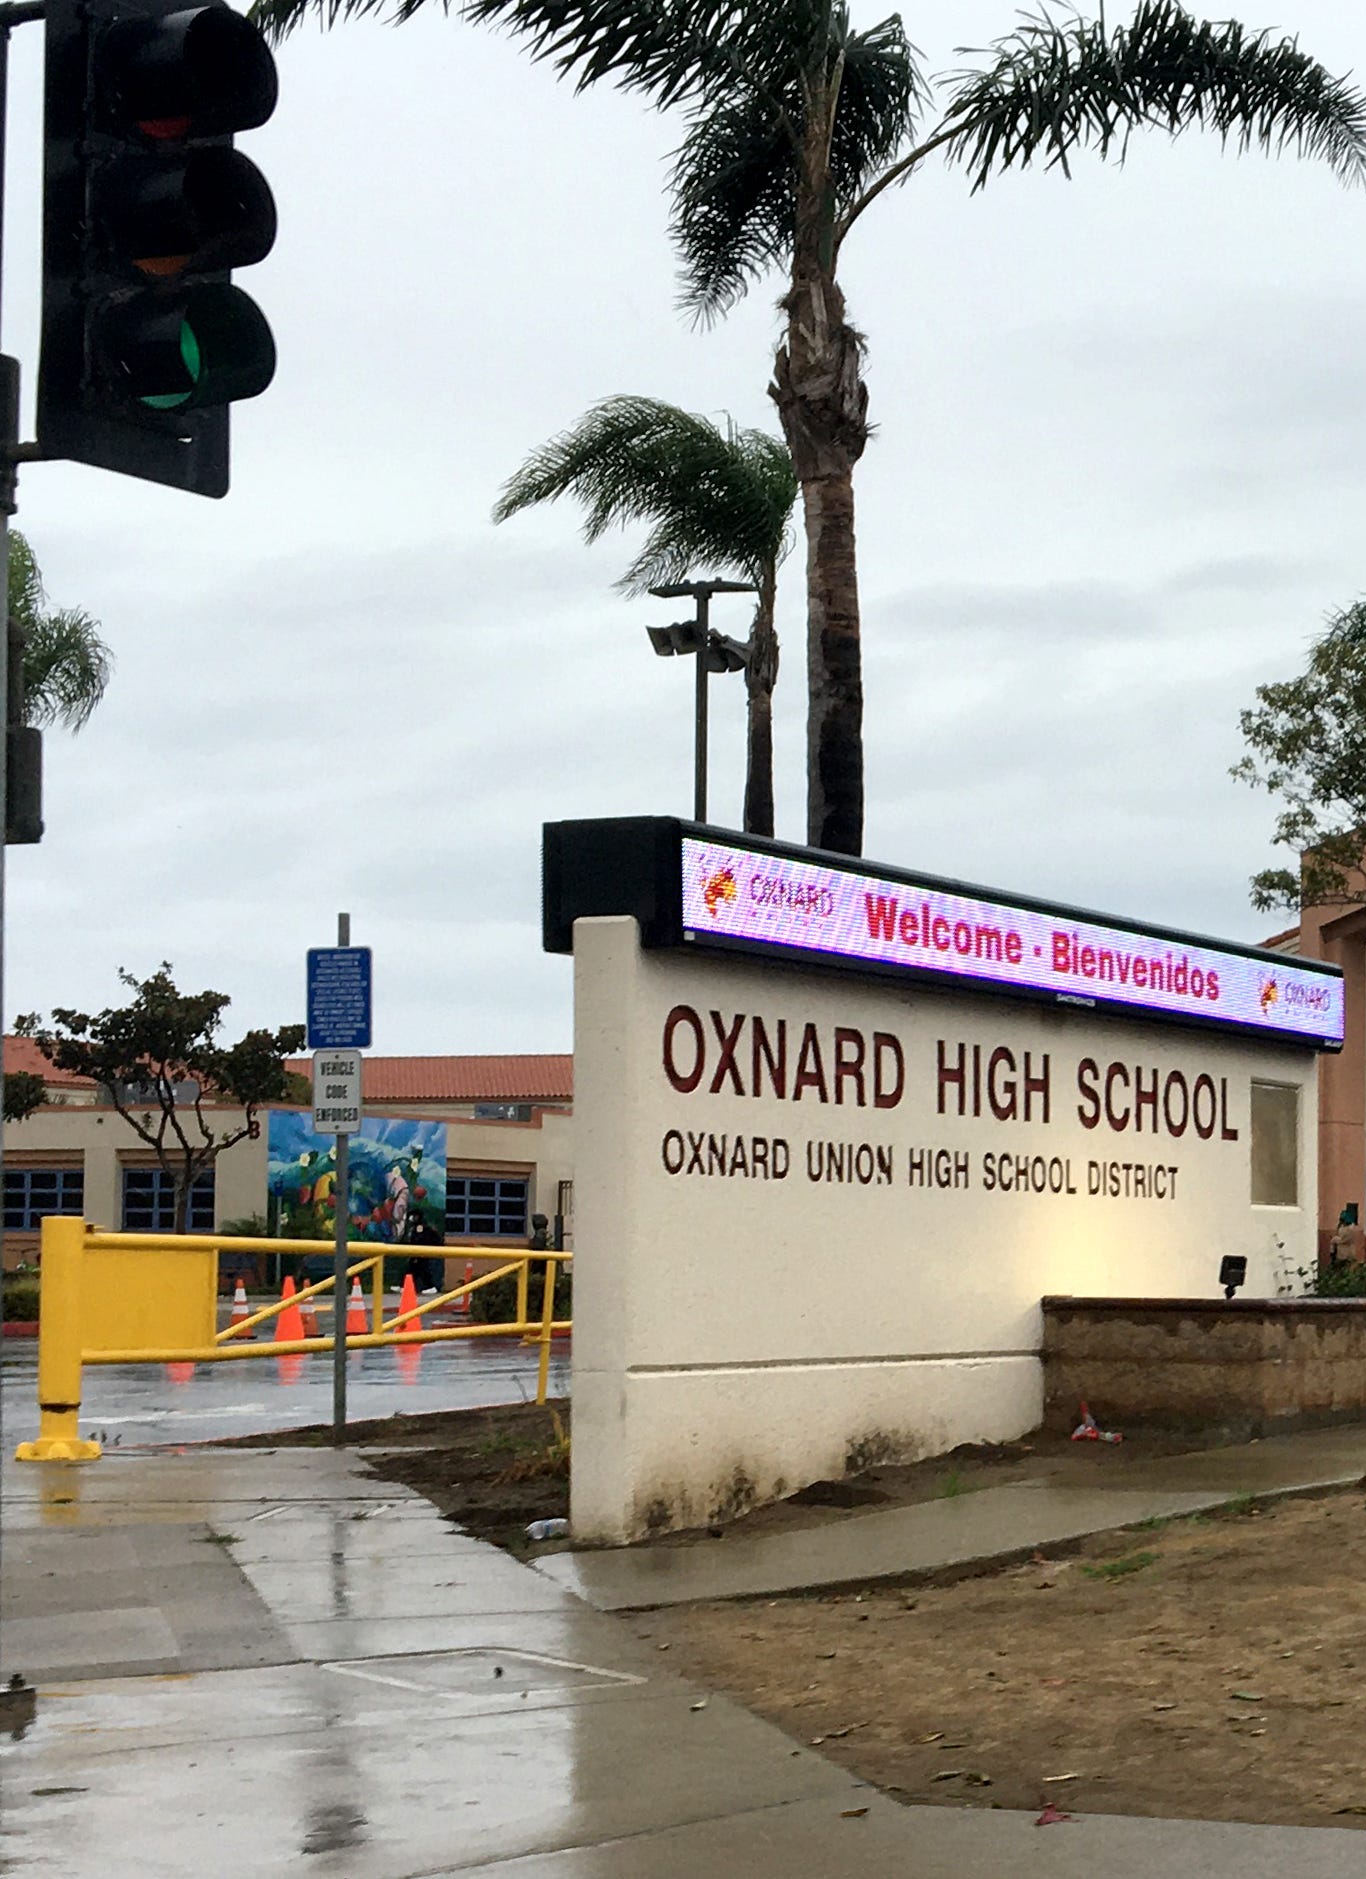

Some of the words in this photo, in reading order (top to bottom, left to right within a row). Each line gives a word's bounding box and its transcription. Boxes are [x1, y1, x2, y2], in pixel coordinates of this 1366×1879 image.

[864, 893, 1023, 965] Welcome
[1052, 929, 1220, 1001] Bienvenidos
[321, 1061, 355, 1076] VEHICLE
[662, 1004, 905, 1109] OXNARD
[937, 1039, 1050, 1124] HIGH
[1077, 1057, 1239, 1141] SCHOOL
[326, 1084, 348, 1099] CODE
[315, 1107, 358, 1122] ENFORCED
[662, 1129, 790, 1180] OXNARD
[806, 1140, 893, 1185] UNION
[908, 1147, 970, 1189] HIGH
[983, 1152, 1078, 1195] SCHOOL
[1088, 1160, 1179, 1200] DISTRICT
